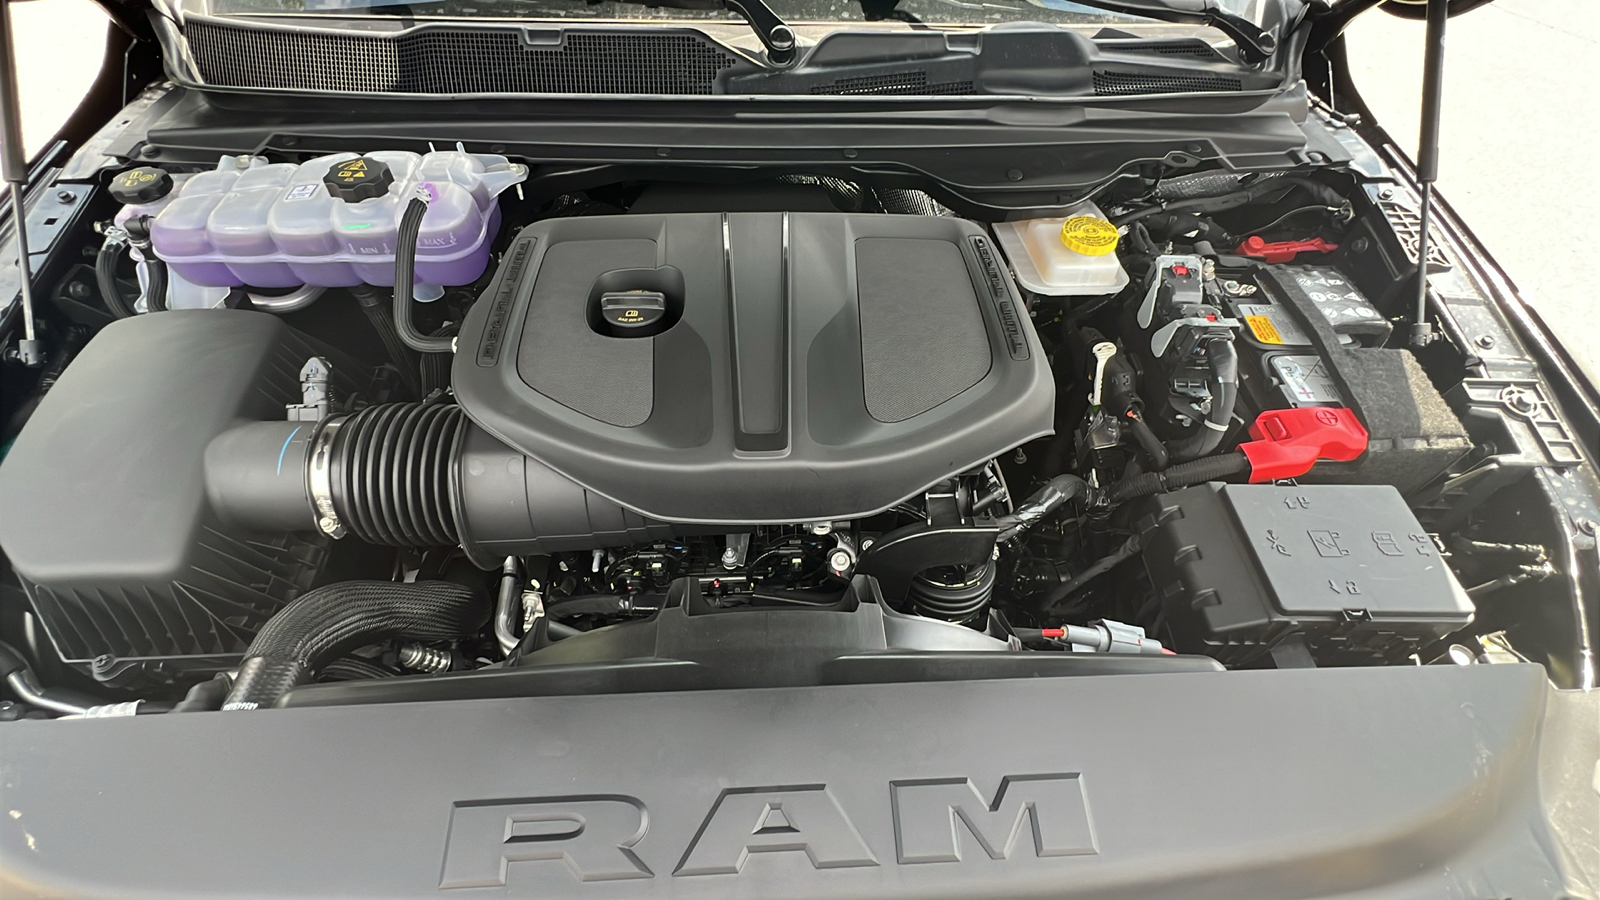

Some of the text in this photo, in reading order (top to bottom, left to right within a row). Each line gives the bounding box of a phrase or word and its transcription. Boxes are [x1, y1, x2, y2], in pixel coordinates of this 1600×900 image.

[359, 247, 379, 255] MIN
[423, 237, 446, 246] MAX
[974, 236, 1004, 298] TURBO
[483, 287, 514, 360] TURBO
[438, 772, 1100, 889] RAM
